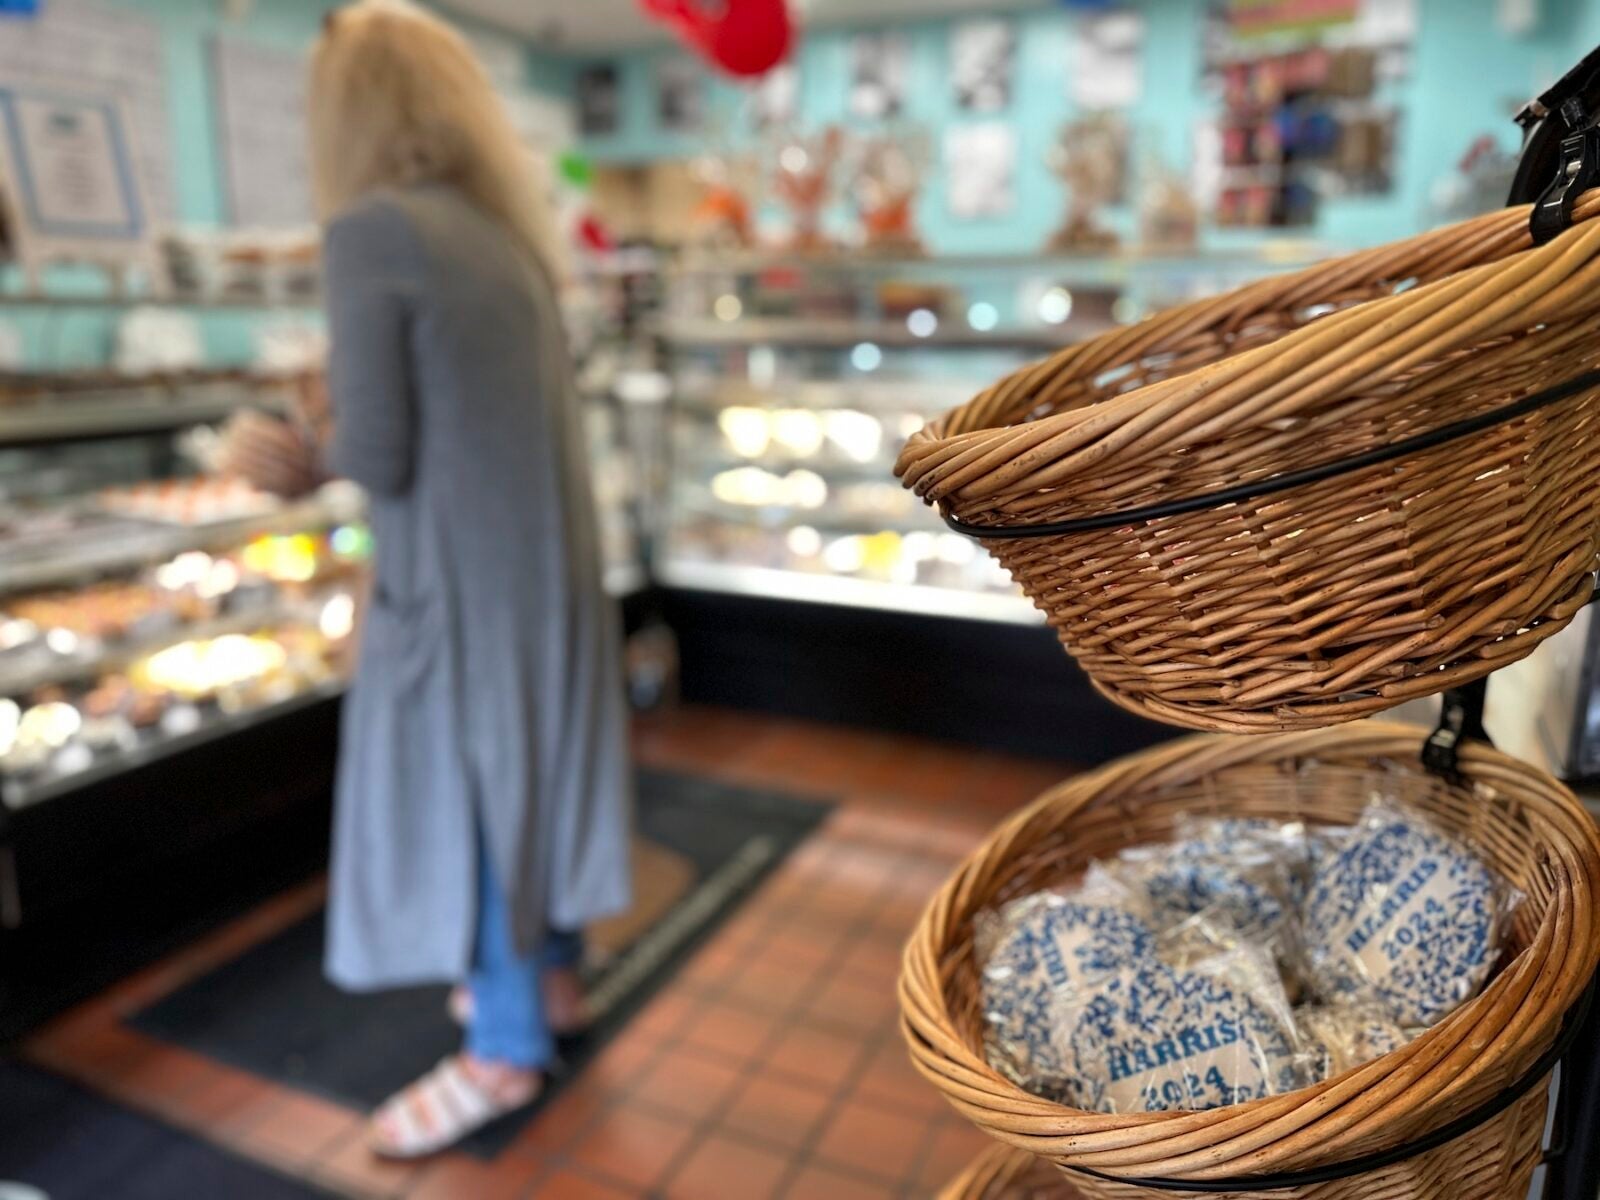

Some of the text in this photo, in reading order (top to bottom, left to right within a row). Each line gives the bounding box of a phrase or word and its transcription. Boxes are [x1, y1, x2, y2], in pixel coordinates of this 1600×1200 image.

[1346, 861, 1438, 953] HARRIS
[1381, 897, 1445, 960] 2024
[1108, 1016, 1238, 1082] HARRIS
[1141, 1065, 1225, 1111] 2024
